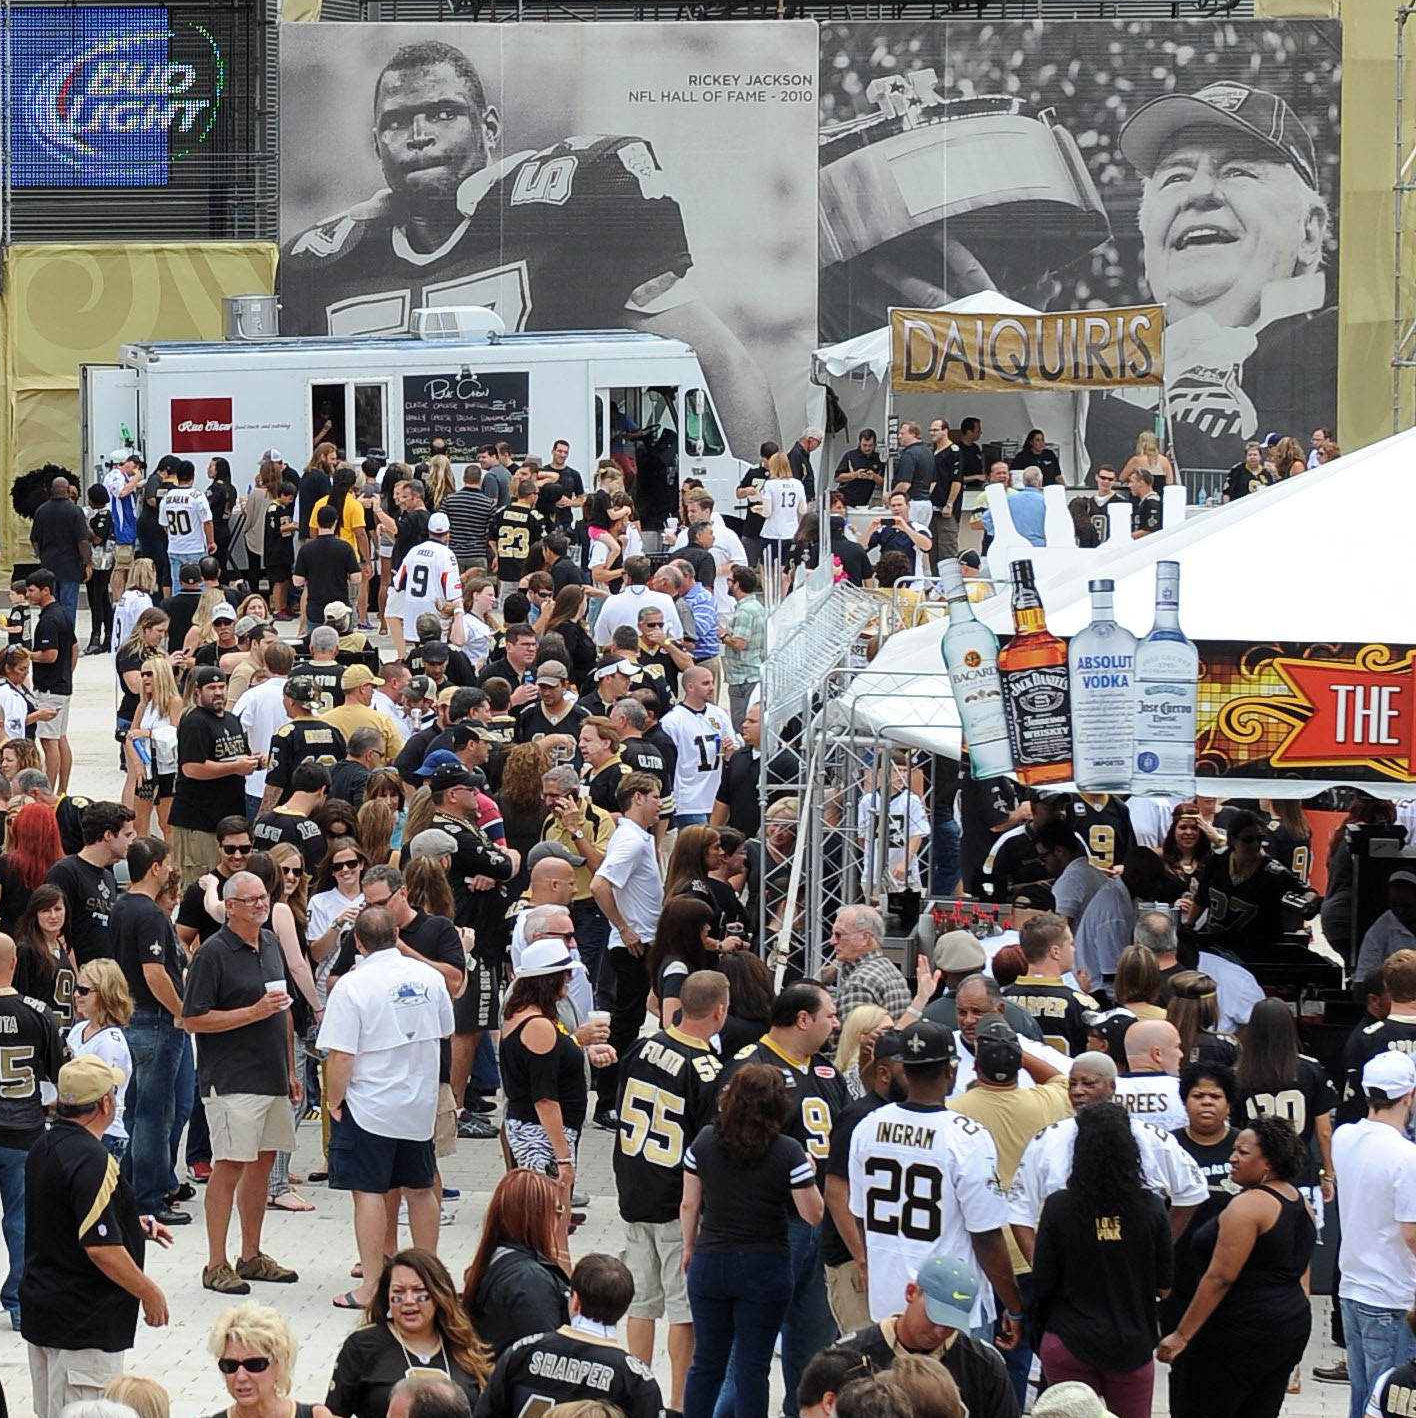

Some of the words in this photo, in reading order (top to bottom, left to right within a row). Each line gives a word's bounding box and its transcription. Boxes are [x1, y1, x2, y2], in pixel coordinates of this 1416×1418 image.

[88, 61, 196, 92] BUD
[688, 75, 741, 86] RICKEY
[746, 75, 813, 86] JACKSON
[628, 91, 656, 102] NFL
[661, 91, 698, 102] HALL
[702, 91, 723, 102] OF
[727, 91, 766, 102] FAME
[780, 91, 813, 102] 2010
[72, 96, 209, 131] LIGHT
[904, 315, 1152, 384] DAIQUIRIS
[165, 509, 192, 536] 80
[498, 526, 530, 557] 23
[410, 565, 430, 598] 9
[1077, 655, 1133, 670] ABSOLUT
[1082, 675, 1129, 688] VODKA
[1137, 701, 1159, 714] Jose
[1160, 701, 1192, 714] Cuervo
[1330, 684, 1400, 744] THE
[1023, 727, 1070, 739] WHISKEY
[1093, 759, 1125, 767] IMPORTED
[639, 1039, 686, 1077] FUJITA
[619, 1076, 686, 1169] 55
[801, 1097, 833, 1159] 9
[876, 1121, 936, 1150] INGRAM
[863, 1157, 944, 1242] 28
[528, 1350, 615, 1392] SHARPER
